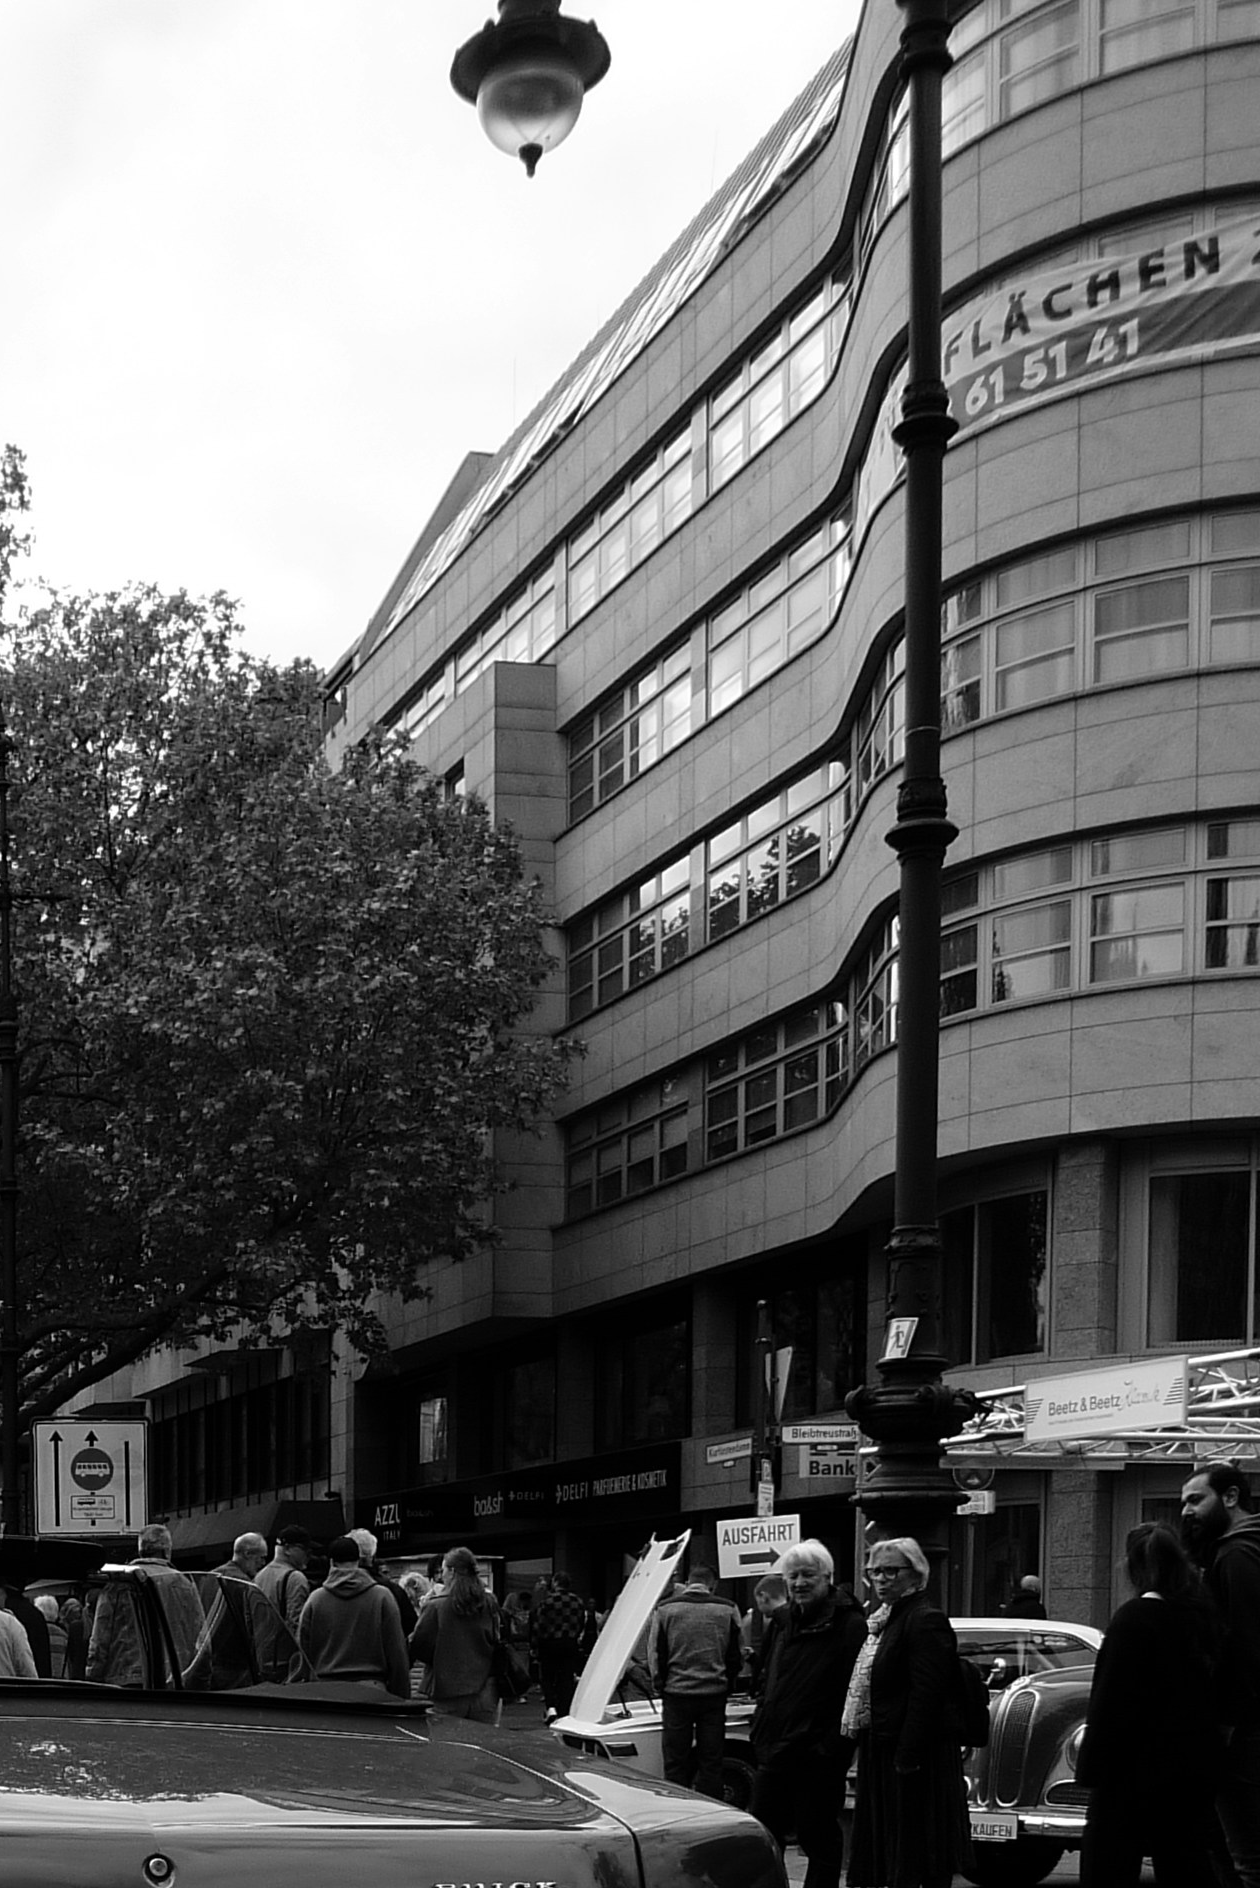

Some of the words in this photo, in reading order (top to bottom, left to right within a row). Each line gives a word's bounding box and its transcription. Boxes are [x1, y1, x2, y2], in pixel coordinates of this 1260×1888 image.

[965, 368, 1004, 416] 61
[1020, 341, 1068, 390] 51
[1086, 317, 1139, 365] 41
[1048, 1400, 1079, 1417] Beetz
[1080, 1397, 1088, 1412] &
[1090, 1394, 1121, 1410] Beetz
[791, 1427, 857, 1440] Bleibtreustraß
[809, 1459, 855, 1476] Bank
[515, 1491, 544, 1501] DELFI
[562, 1480, 589, 1502] DELFI
[722, 1523, 795, 1546] AUSFAHRT
